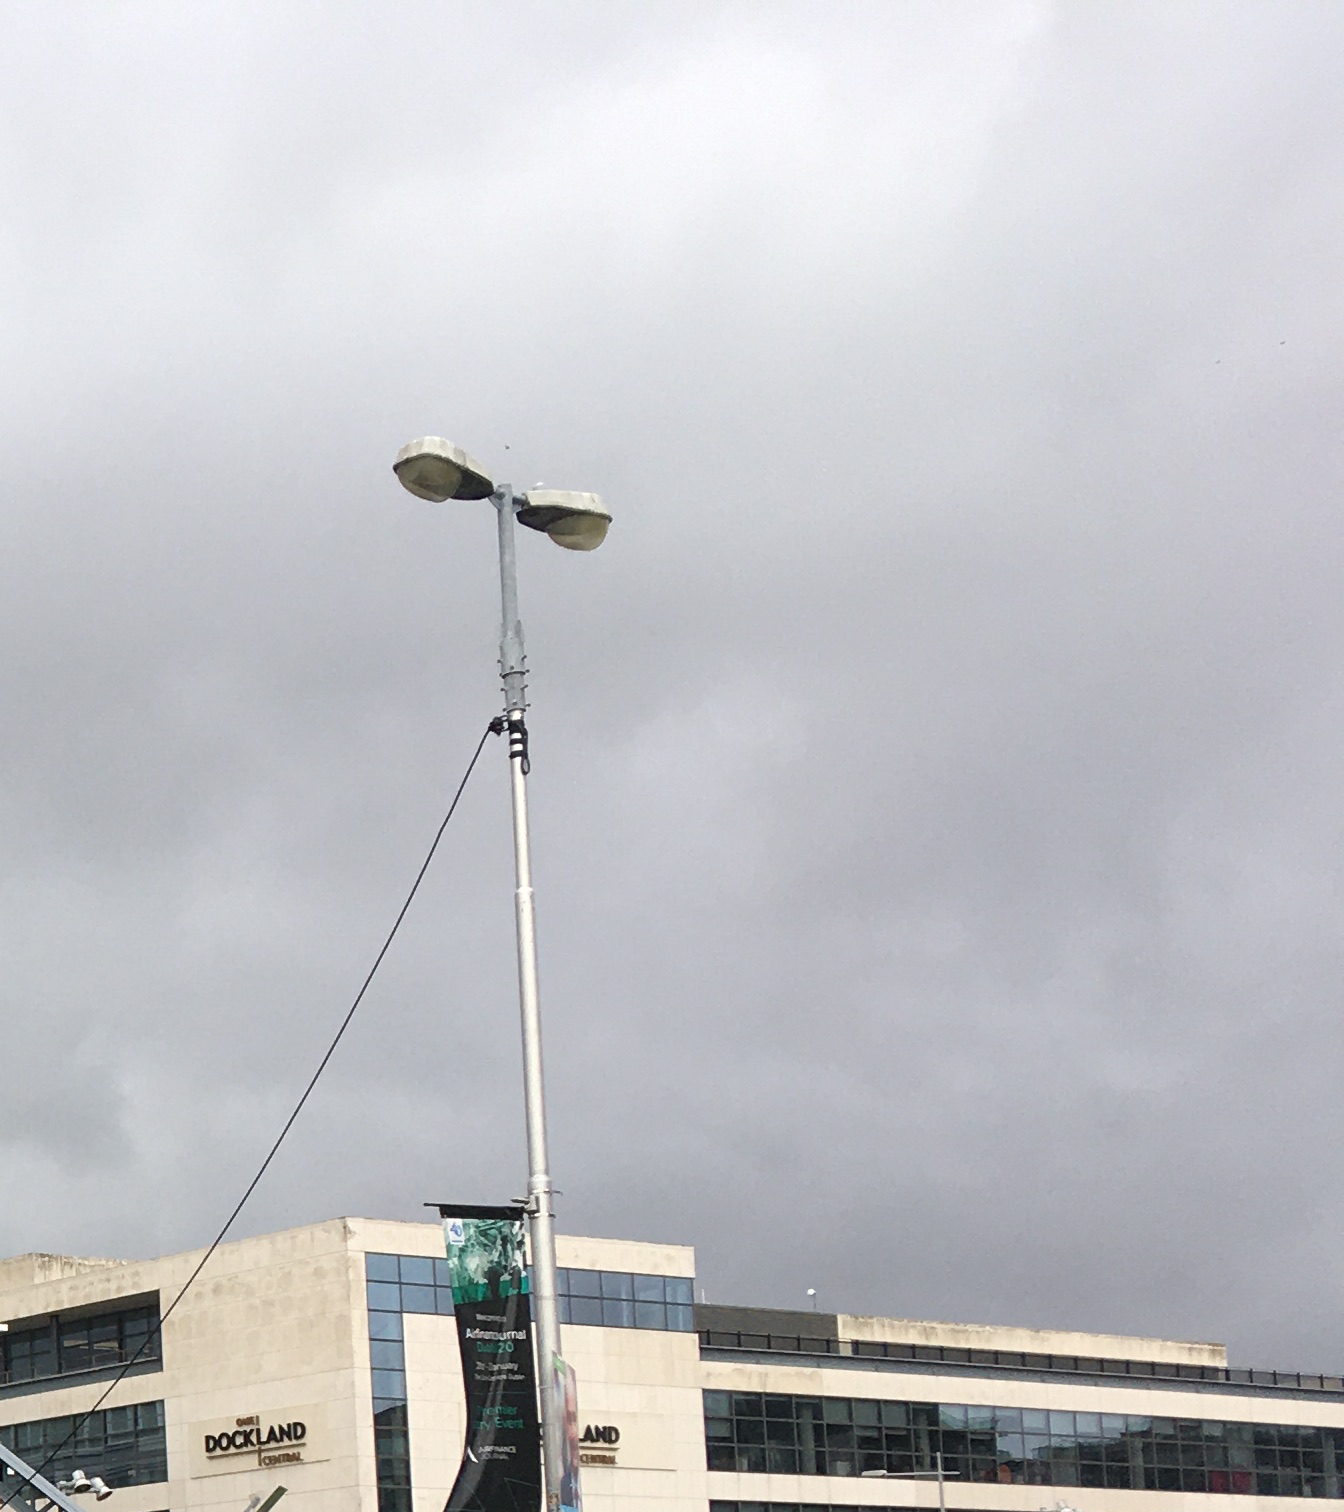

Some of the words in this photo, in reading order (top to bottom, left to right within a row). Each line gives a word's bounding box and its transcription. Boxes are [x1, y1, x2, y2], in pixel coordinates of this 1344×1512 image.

[494, 1417, 524, 1429] Event
[204, 1421, 306, 1453] DOCKLAND
[262, 1451, 304, 1466] CENTRAL
